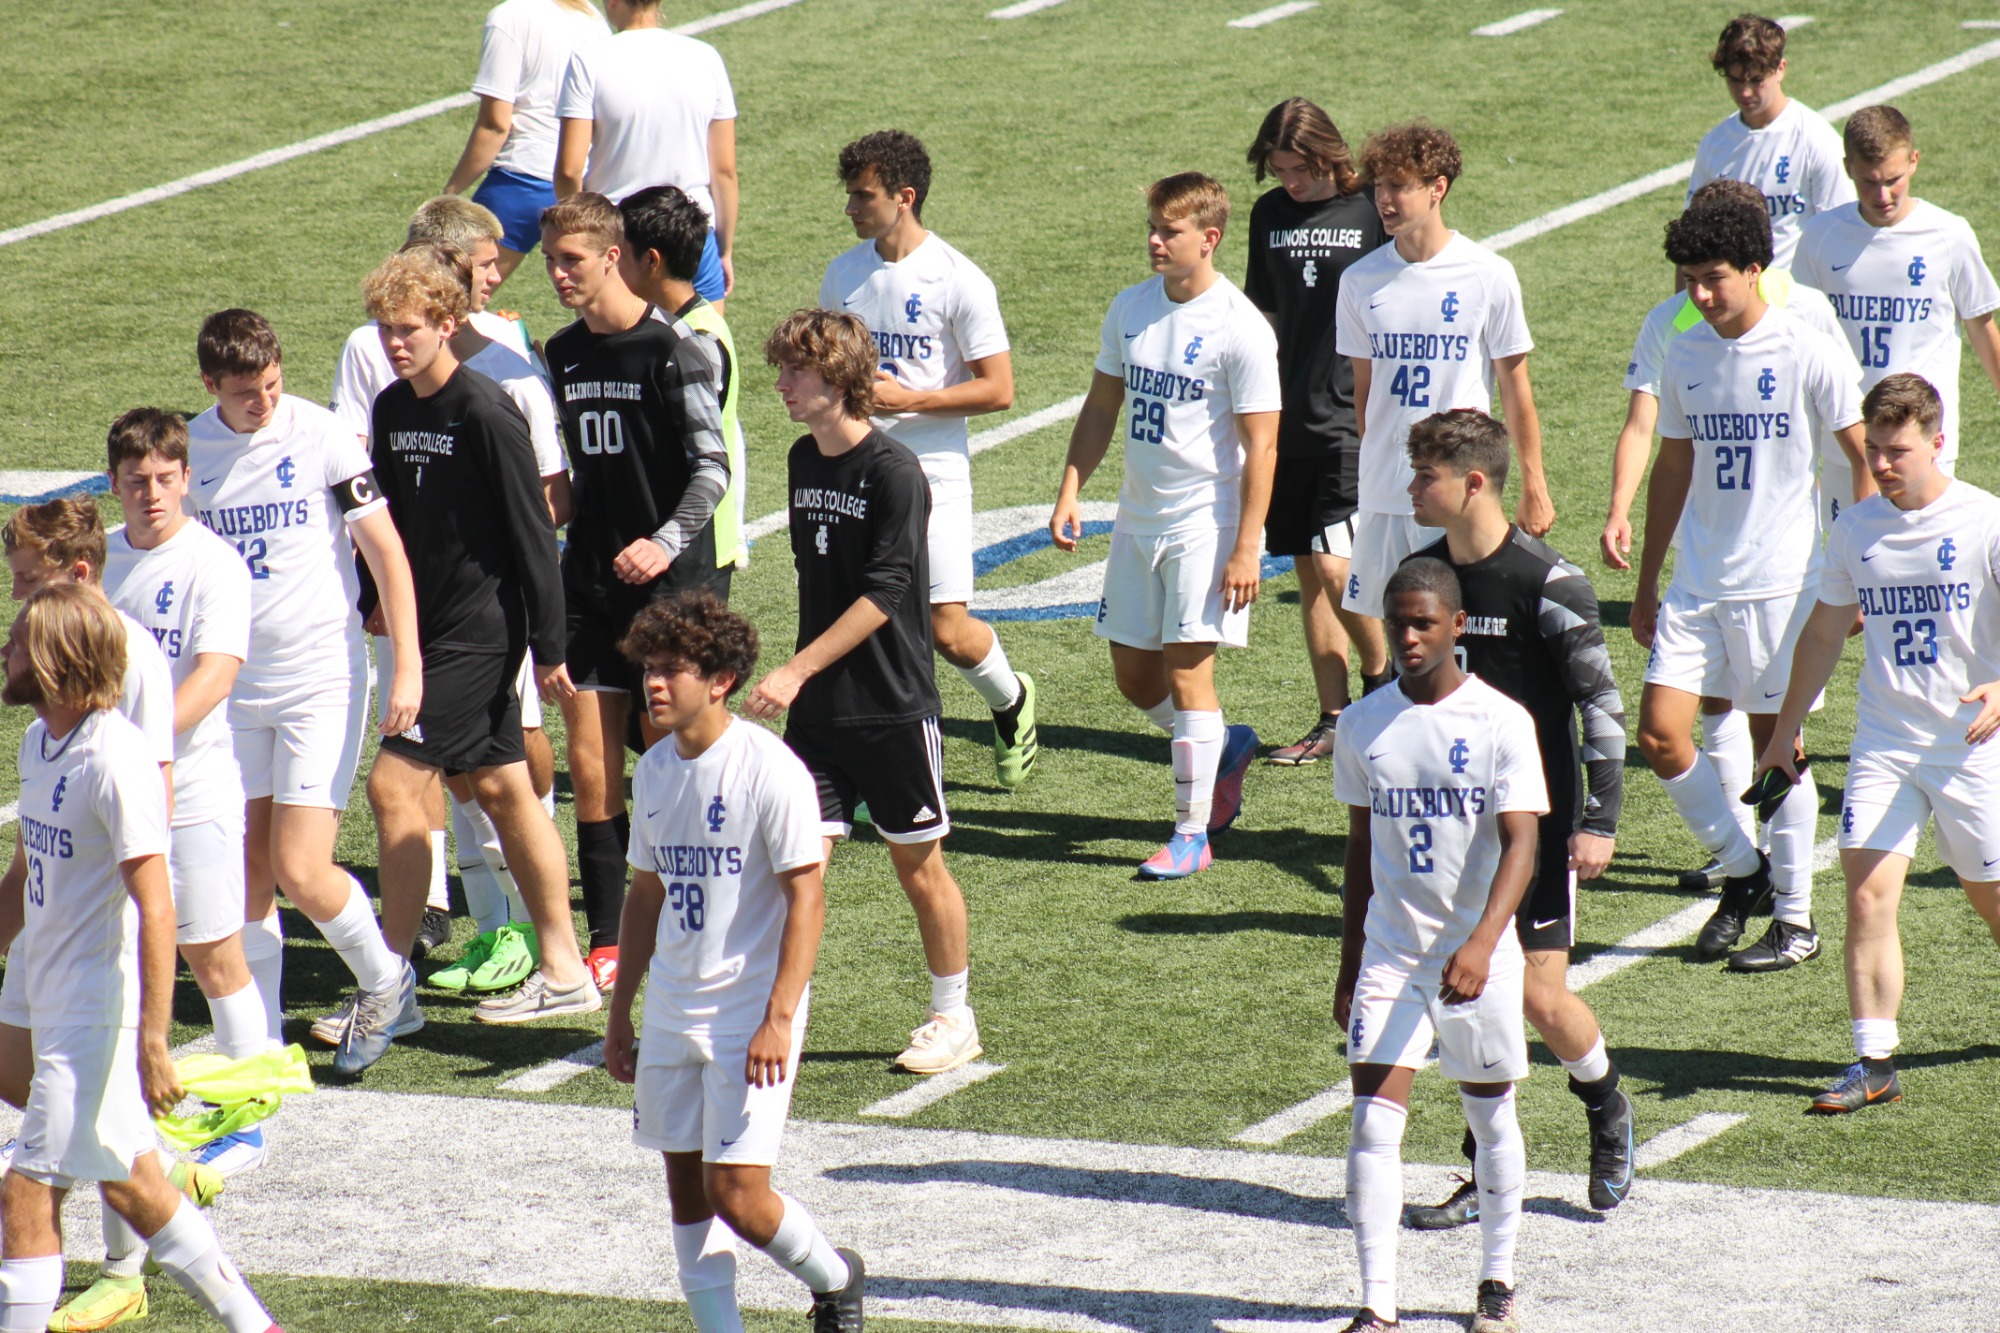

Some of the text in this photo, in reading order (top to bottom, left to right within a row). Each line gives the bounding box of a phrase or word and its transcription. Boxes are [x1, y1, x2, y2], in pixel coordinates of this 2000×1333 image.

[1269, 228, 1362, 249] ILLINOIS COLLEGE
[1290, 250, 1330, 258] SOCCER
[1828, 294, 1932, 323] BLUEBOYS
[869, 331, 932, 359] EBOYS
[1861, 326, 1892, 368] 15
[564, 381, 641, 402] ILLINOIS COLLEGE
[1122, 363, 1205, 401] LUEBOYS
[1390, 365, 1430, 407] 42
[579, 411, 624, 455] 00
[1131, 397, 1165, 444] 29
[418, 431, 454, 455] COLLEGE
[1715, 446, 1752, 490] 27
[351, 476, 373, 504] C
[824, 490, 867, 519] COLLEGE
[237, 537, 270, 580] 2
[1858, 582, 1970, 616] BLUEBOYS
[1893, 619, 1938, 666] 23
[1370, 787, 1485, 818] BLUEBOYS
[22, 815, 73, 859] UEBOYS
[1409, 824, 1434, 873] 2
[651, 845, 743, 877] LUEBOYS
